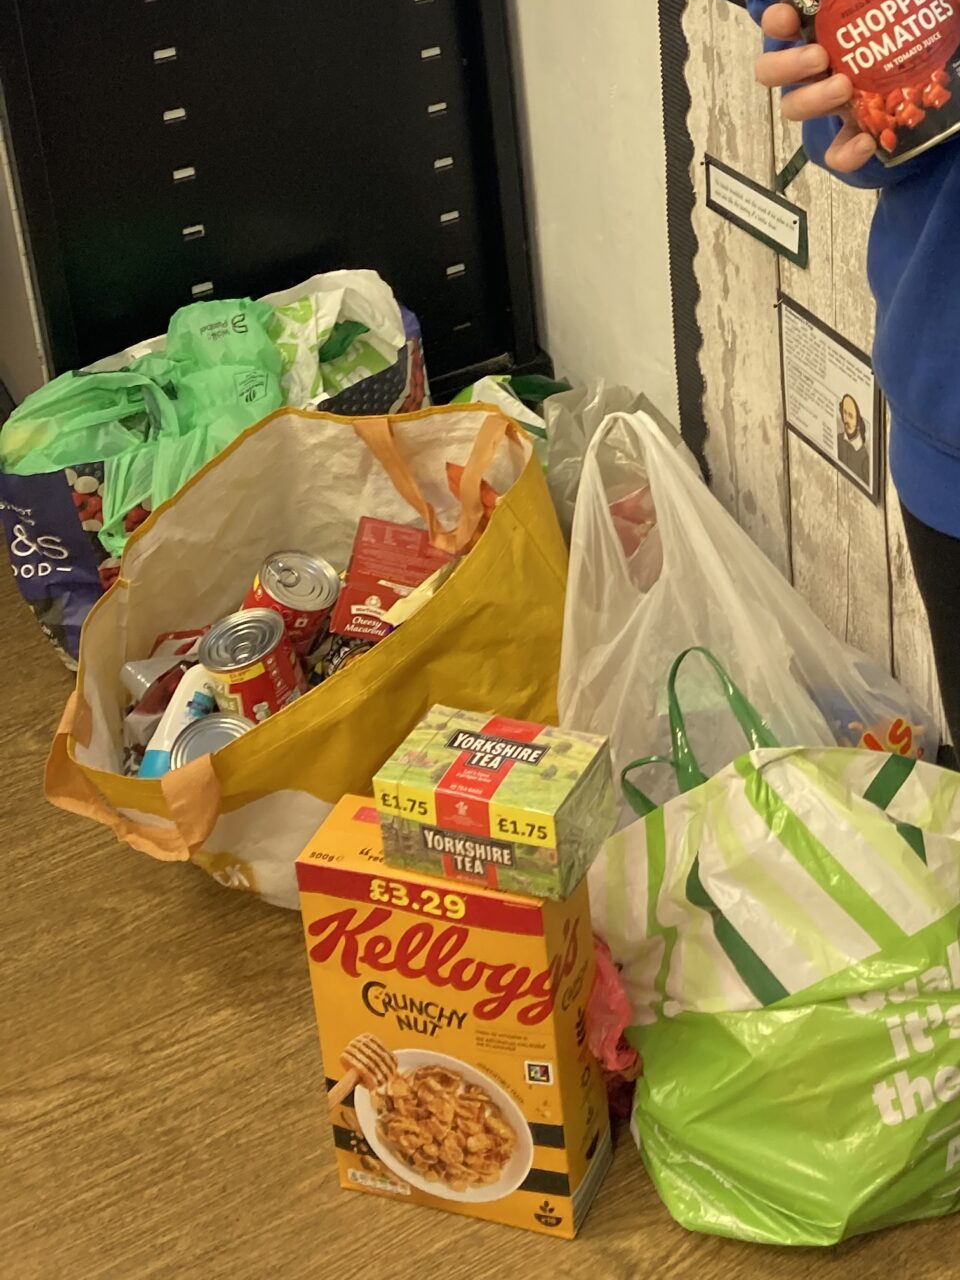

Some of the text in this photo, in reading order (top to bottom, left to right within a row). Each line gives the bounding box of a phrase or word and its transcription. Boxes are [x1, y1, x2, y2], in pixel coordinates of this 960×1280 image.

[883, 31, 942, 72] IN TOMATO JUICE
[11, 524, 68, 559] &S
[11, 562, 52, 578] OD
[344, 623, 388, 637] Macaroni
[352, 616, 382, 629] Cheesy
[452, 732, 543, 763] YORKSHIRE
[470, 752, 502, 769] TEA
[381, 793, 428, 816] £1.75
[498, 818, 548, 841] £1.75
[423, 829, 513, 865] YORKSHIRE
[454, 855, 484, 875] TEA
[369, 878, 467, 920] £3.29
[361, 981, 468, 1030] CRUNCHY
[398, 1016, 443, 1037] NUT
